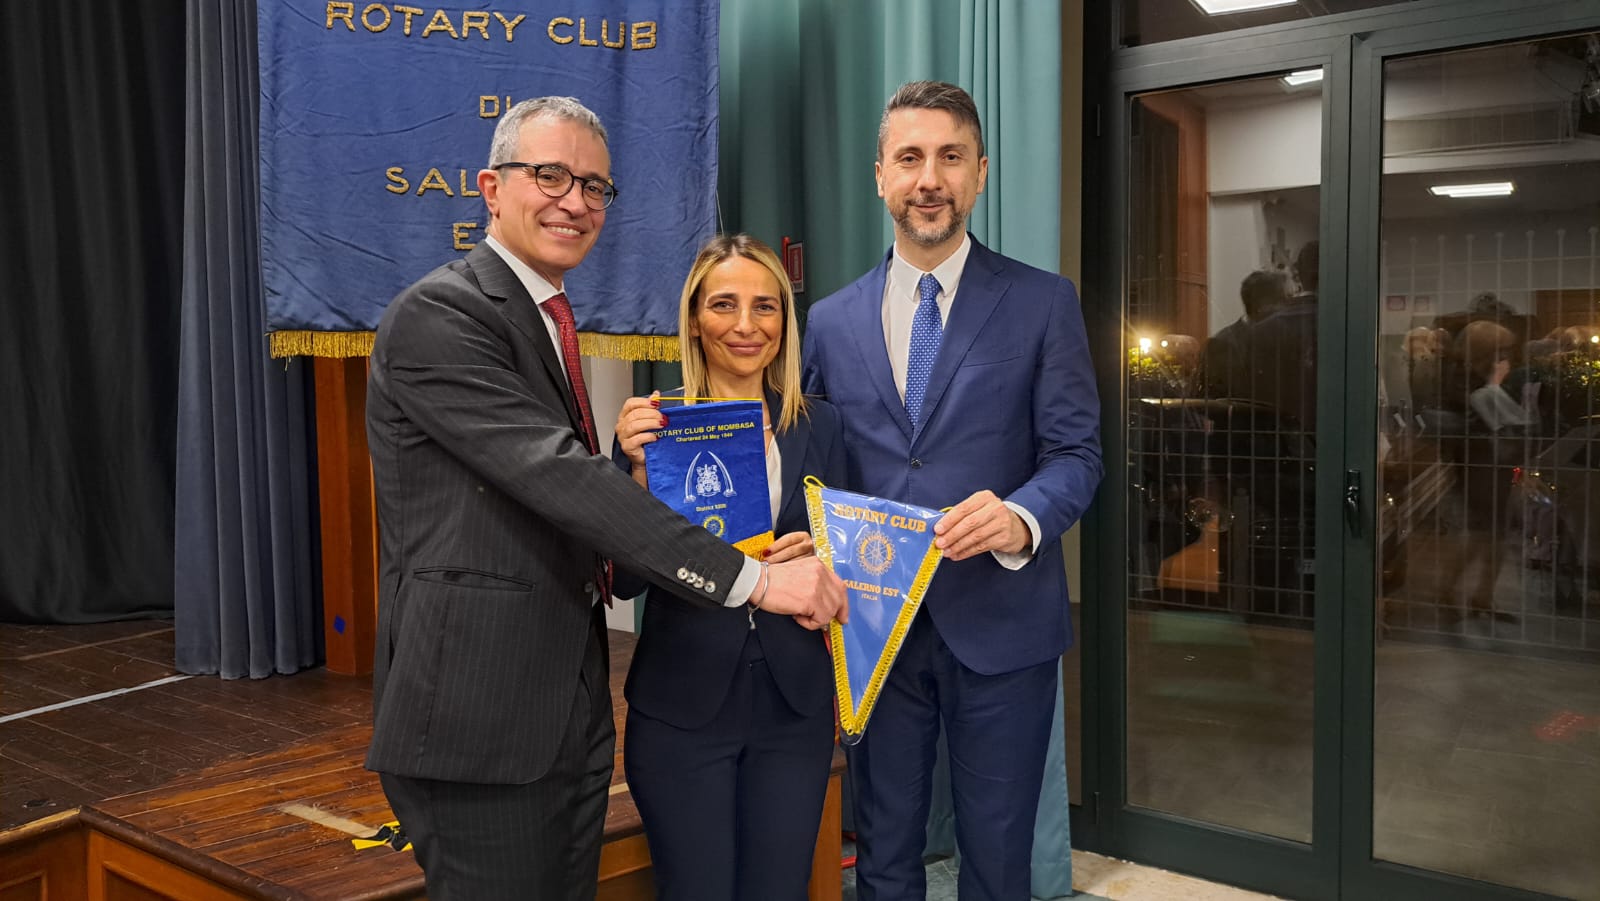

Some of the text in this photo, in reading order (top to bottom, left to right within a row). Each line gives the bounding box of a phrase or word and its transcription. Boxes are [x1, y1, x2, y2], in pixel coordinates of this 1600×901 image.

[325, 1, 657, 50] ROTARY CLUB
[385, 166, 481, 196] SAL
[684, 427, 704, 435] CLUB
[717, 422, 755, 431] MOMBASA
[834, 503, 927, 532] ROTARY CLUB
[882, 587, 899, 597] EST
